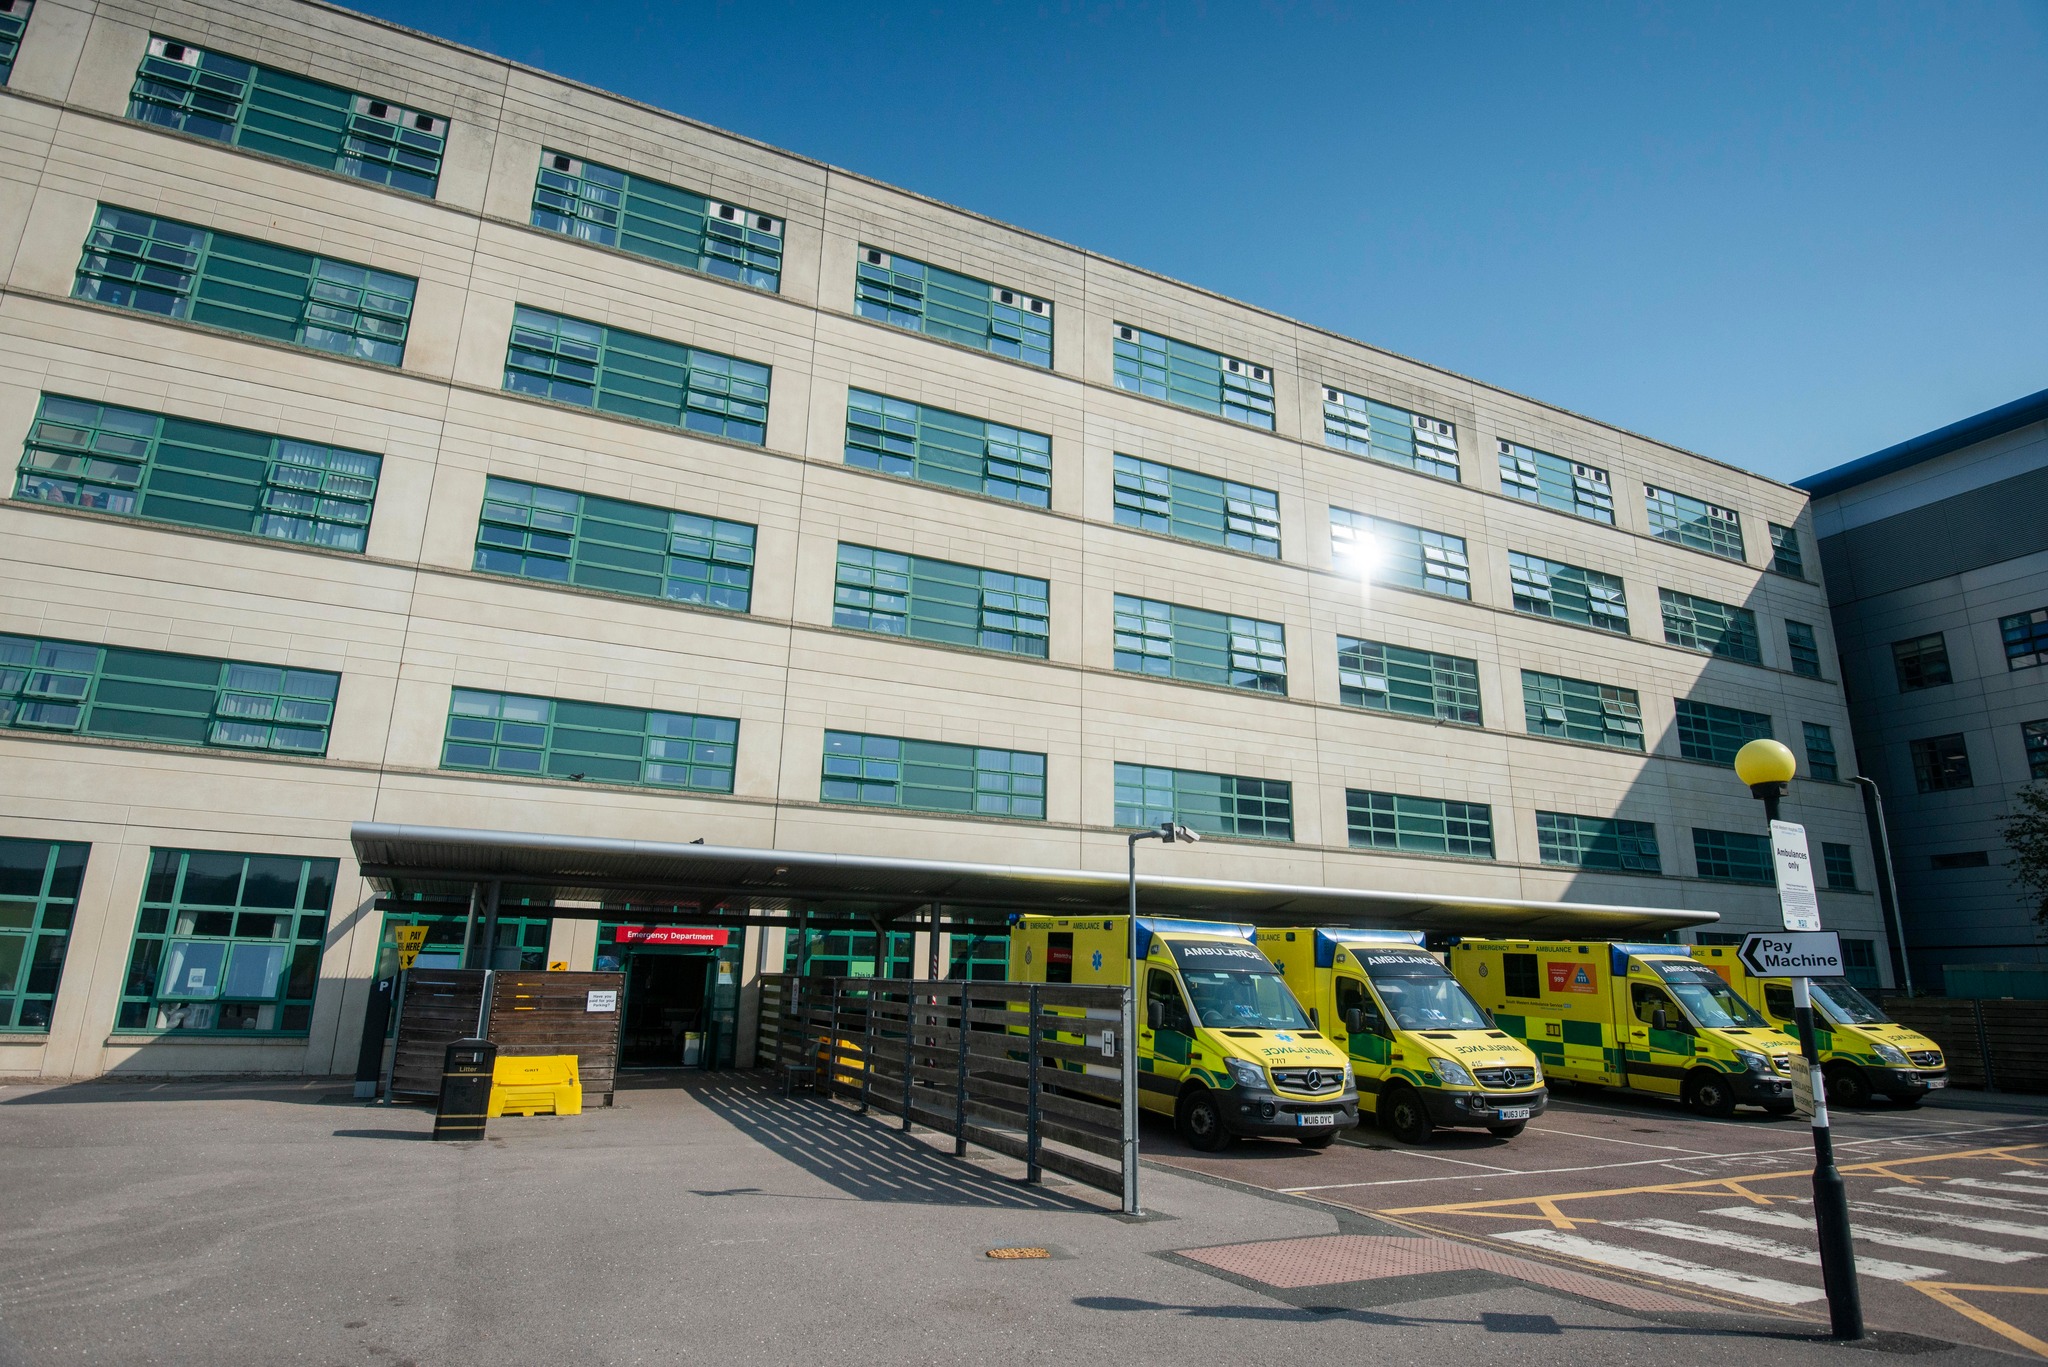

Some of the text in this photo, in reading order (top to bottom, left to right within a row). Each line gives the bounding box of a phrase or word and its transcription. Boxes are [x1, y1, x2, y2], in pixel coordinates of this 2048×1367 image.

[1776, 848, 1807, 859] Ambulances
[1788, 861, 1799, 871] only
[1073, 922, 1100, 930] AMBULANCE
[410, 931, 421, 940] PAY
[627, 931, 714, 942] Emergency Department
[405, 942, 421, 951] HERE
[1762, 940, 1792, 954] Pay
[1184, 948, 1262, 960] AMBULANCE
[1367, 956, 1441, 967] AMBULANCE
[1765, 954, 1838, 967] Machine
[1661, 965, 1715, 975] AMBULANCE
[379, 982, 389, 991] P
[1303, 1114, 1332, 1124] WU16 OYC
[1503, 1110, 1529, 1119] WU63 UFP
